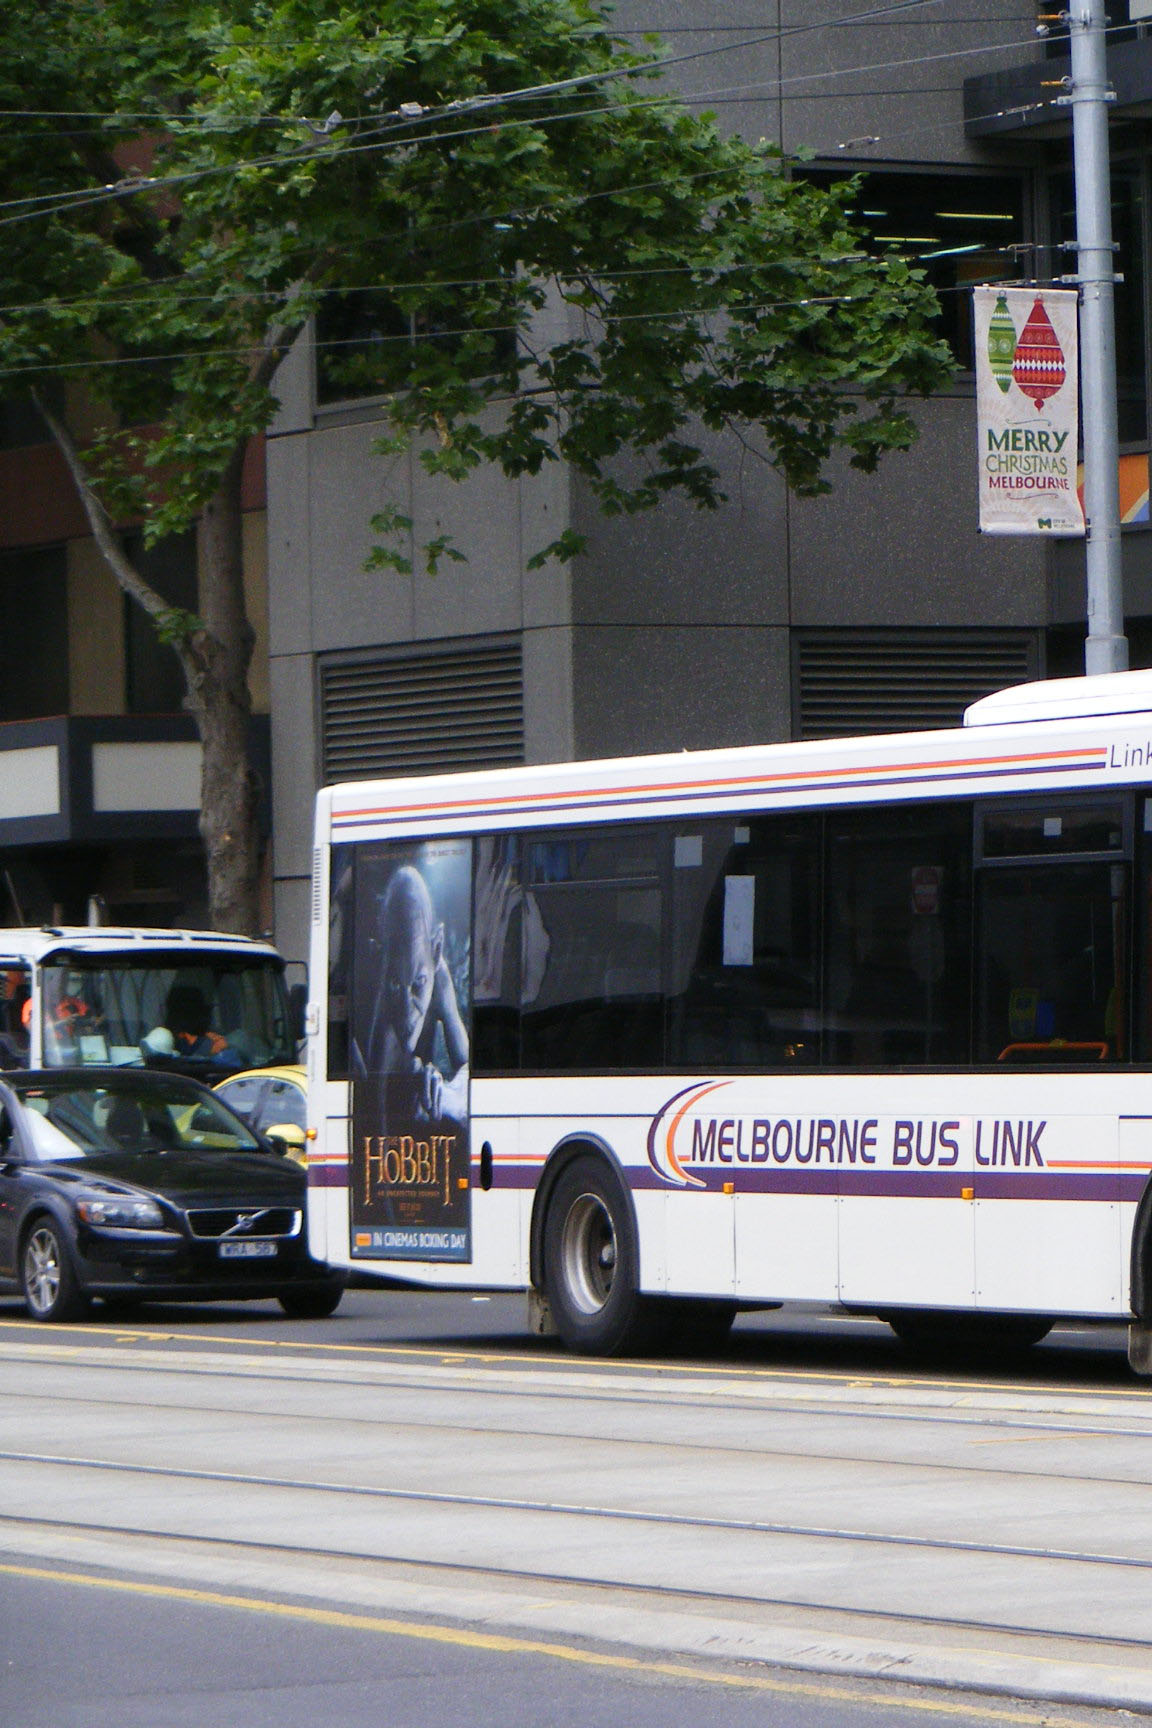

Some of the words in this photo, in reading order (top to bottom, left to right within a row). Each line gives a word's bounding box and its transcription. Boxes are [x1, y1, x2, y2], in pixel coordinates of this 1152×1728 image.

[987, 428, 1070, 453] MERRY
[985, 454, 1068, 476] CHRISTMAS
[988, 476, 1070, 490] MELBOURNE
[691, 1119, 878, 1163] MELBOURNE
[892, 1120, 960, 1166] BUS
[975, 1120, 1048, 1167] LINK
[373, 1232, 382, 1246] IN
[384, 1232, 418, 1247] CINEMAS
[420, 1233, 449, 1248] BOXING
[451, 1233, 467, 1248] DAY
